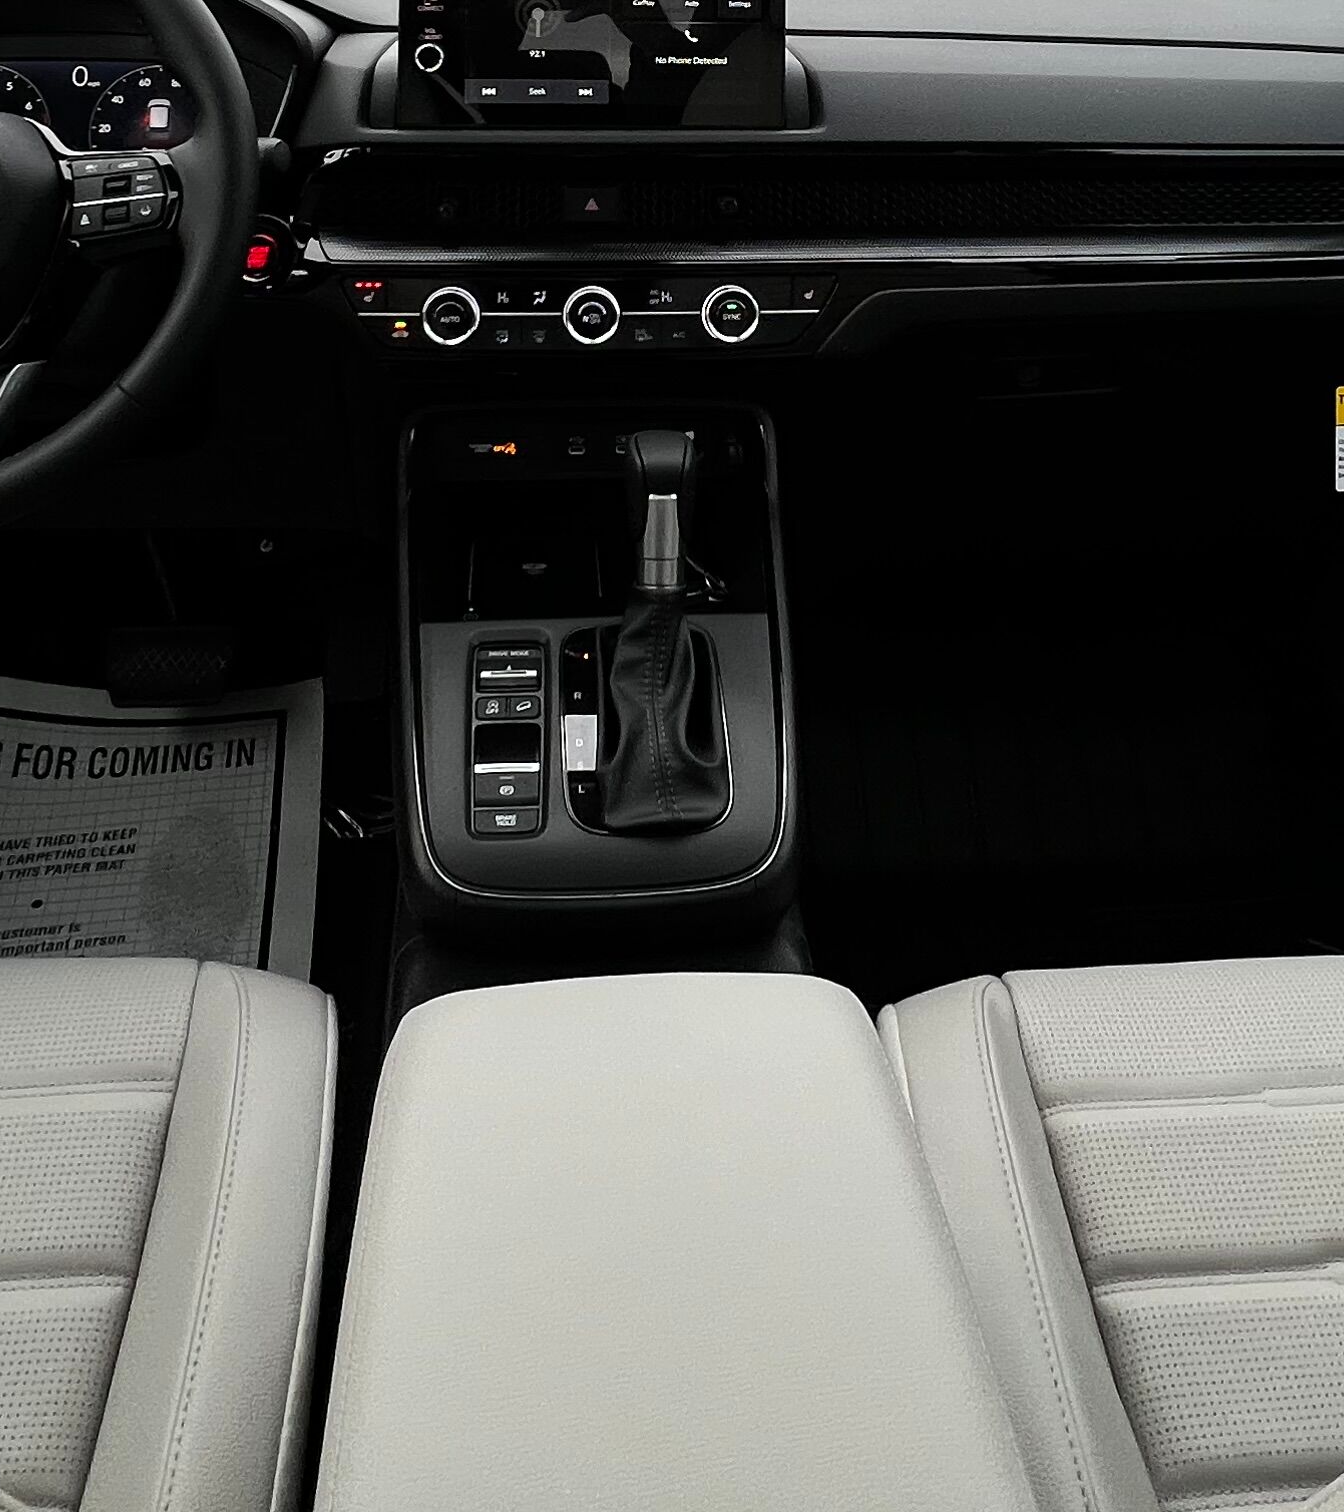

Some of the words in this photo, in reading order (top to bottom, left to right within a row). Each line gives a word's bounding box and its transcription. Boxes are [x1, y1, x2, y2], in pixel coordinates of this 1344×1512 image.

[684, 0, 700, 8] Auto
[728, 0, 752, 9] Settings
[529, 50, 546, 58] 92.1
[655, 56, 667, 65] No
[667, 56, 692, 65] Phone
[693, 56, 728, 65] Detected
[71, 65, 89, 87] 0
[6, 81, 15, 92] 5
[138, 77, 152, 88] 60
[528, 87, 547, 96] Seek
[111, 94, 125, 105] 40
[24, 100, 33, 111] 6
[97, 123, 112, 134] 20
[439, 316, 461, 324] AUTO
[722, 314, 741, 322] SYNC
[573, 690, 582, 700] R
[575, 738, 584, 747] D
[11, 743, 77, 780] FOR
[87, 741, 215, 779] COMING
[224, 738, 257, 769] IN
[577, 784, 586, 794] L
[35, 834, 77, 849] TRIED
[80, 832, 99, 844] TO
[102, 827, 138, 842] KEEP
[5, 848, 87, 867] CARPETING
[90, 843, 138, 859] CLEAN
[7, 866, 41, 881] THIS
[44, 862, 91, 877] PAPER
[95, 859, 126, 873] MAT
[68, 922, 82, 935] is
[74, 933, 127, 953] person
